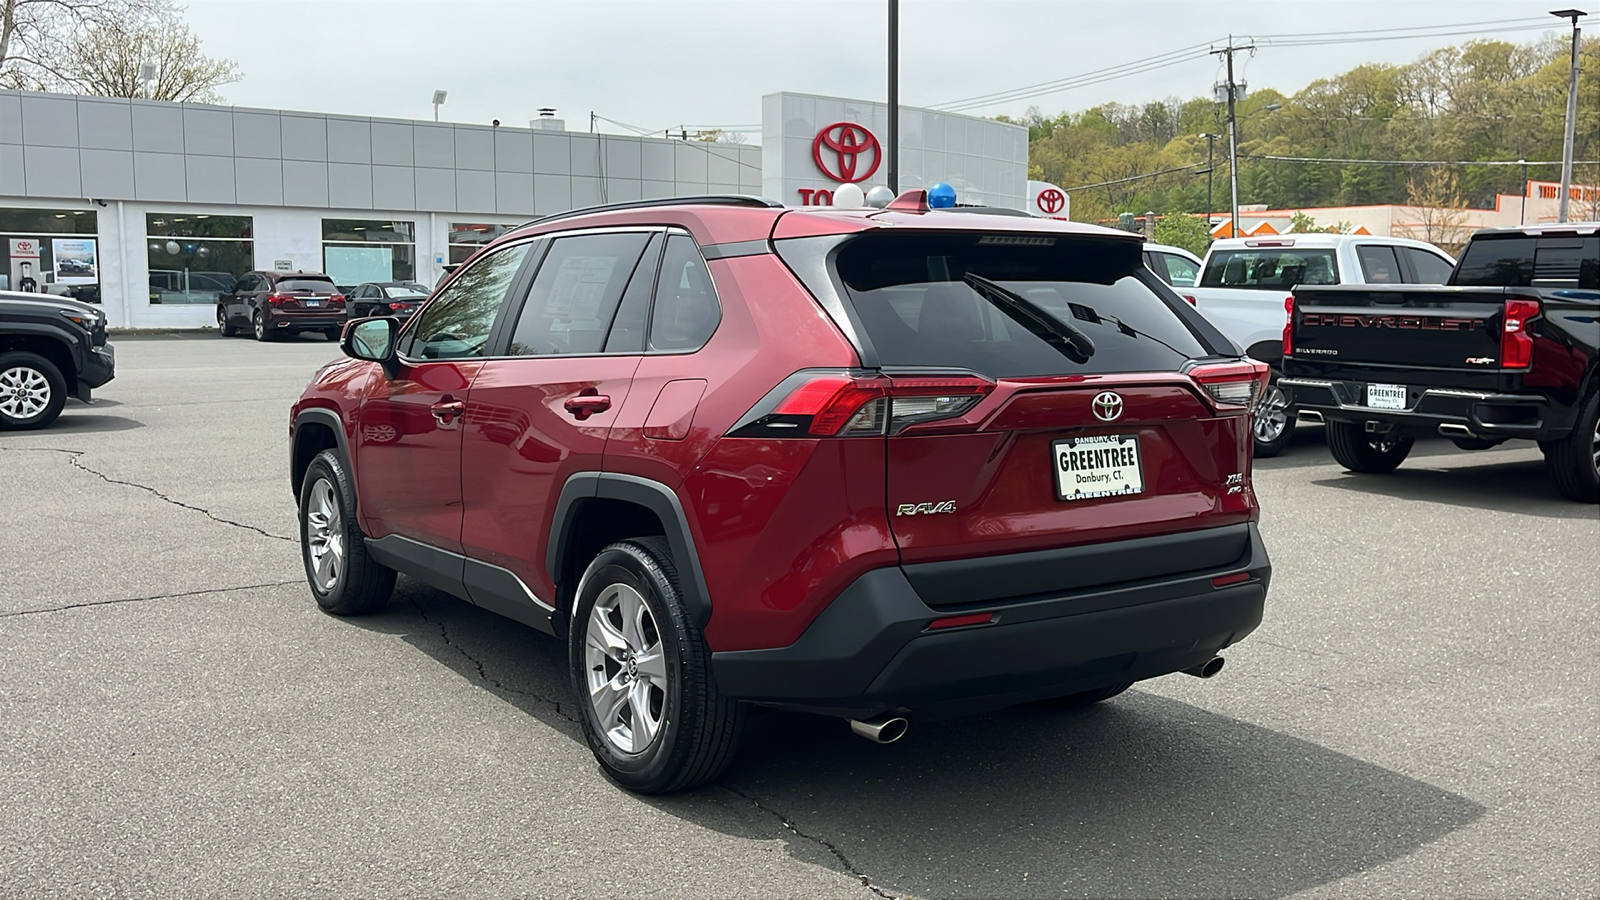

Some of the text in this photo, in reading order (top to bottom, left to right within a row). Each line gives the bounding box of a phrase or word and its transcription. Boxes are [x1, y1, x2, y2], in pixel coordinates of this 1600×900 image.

[1304, 314, 1484, 331] CHEVROLET
[1295, 347, 1338, 356] SILVERADO
[1369, 388, 1404, 399] GREENTREE
[1110, 434, 1120, 442] CT
[1059, 446, 1135, 472] GREENTREE
[1076, 470, 1124, 484] Danbury, CT.
[1226, 473, 1243, 485] XLE
[1066, 487, 1142, 501] GREENTREE
[896, 500, 957, 517] RAV4
